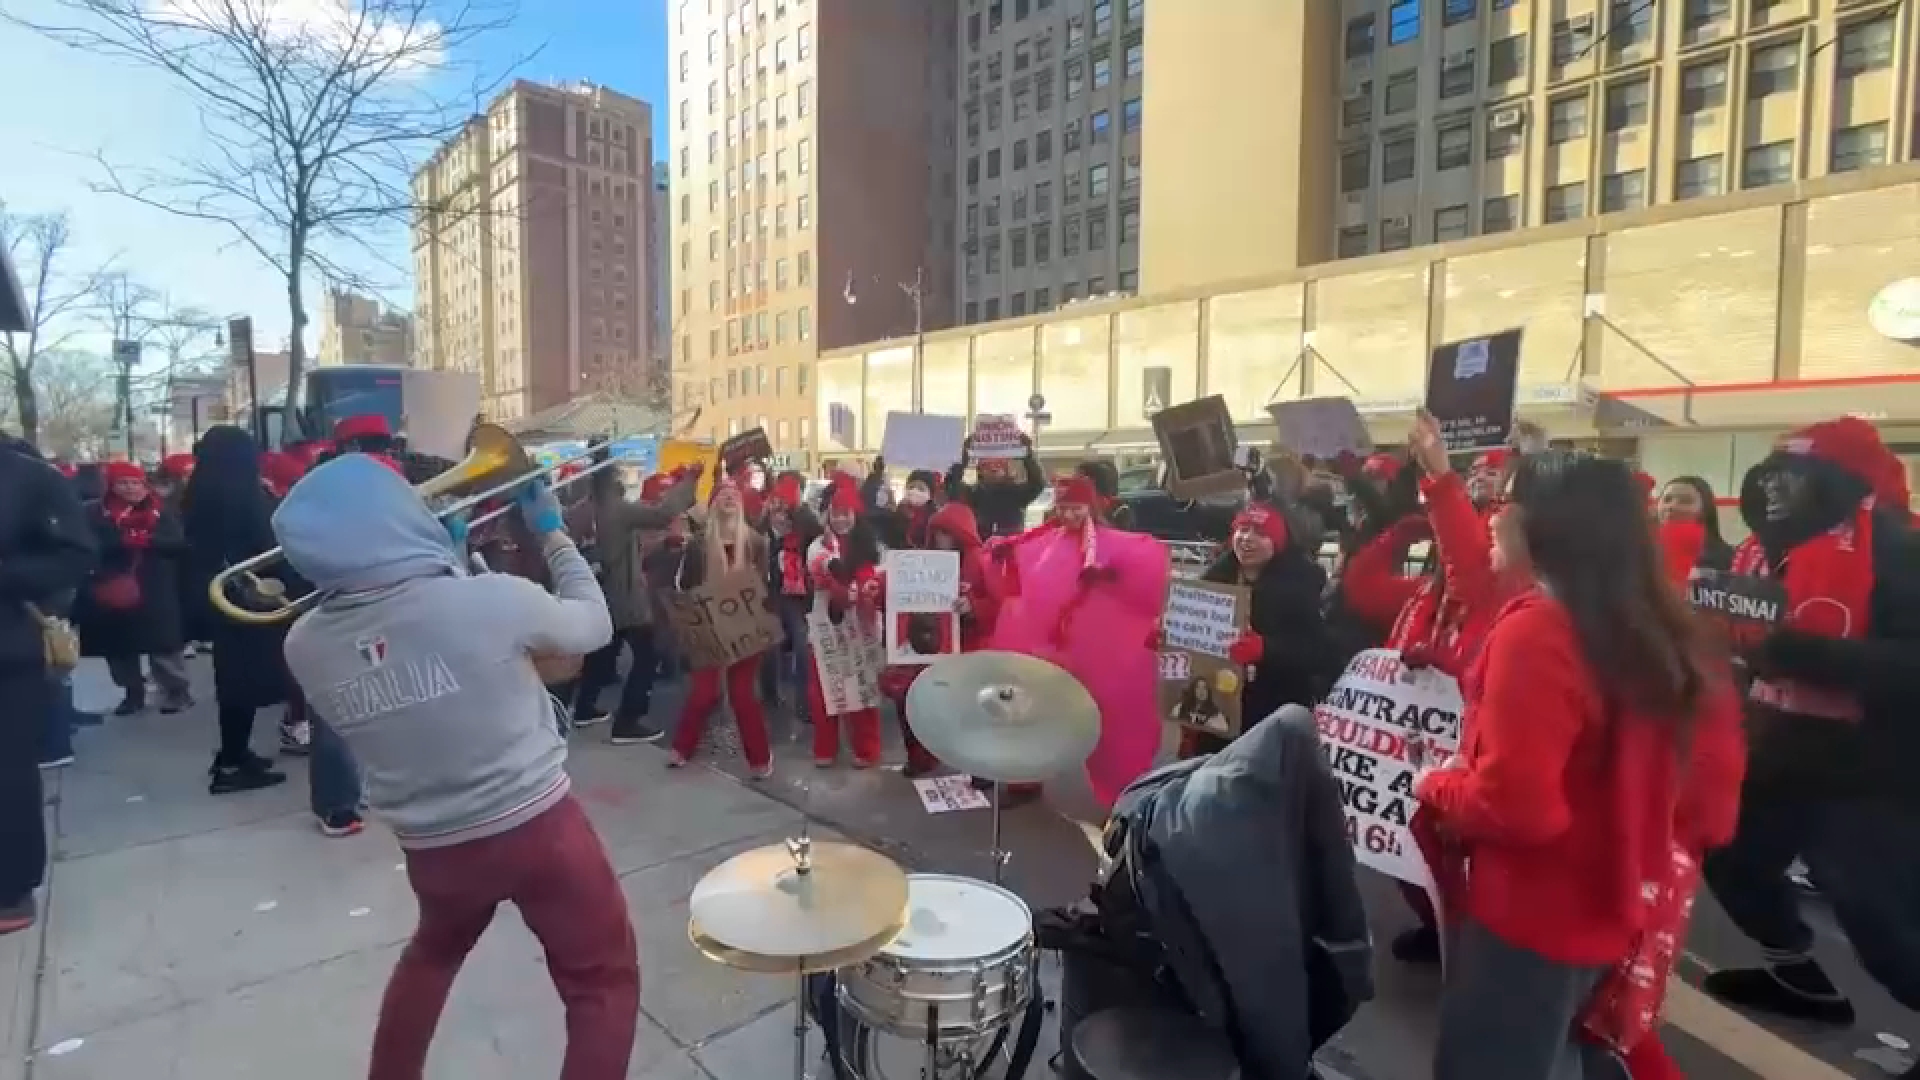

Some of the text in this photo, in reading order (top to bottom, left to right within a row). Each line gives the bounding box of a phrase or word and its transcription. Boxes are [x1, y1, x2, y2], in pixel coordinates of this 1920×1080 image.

[1728, 592, 1777, 621] SINAI
[331, 651, 461, 722] ITALIA
[1326, 686, 1457, 740] ONTRACT
